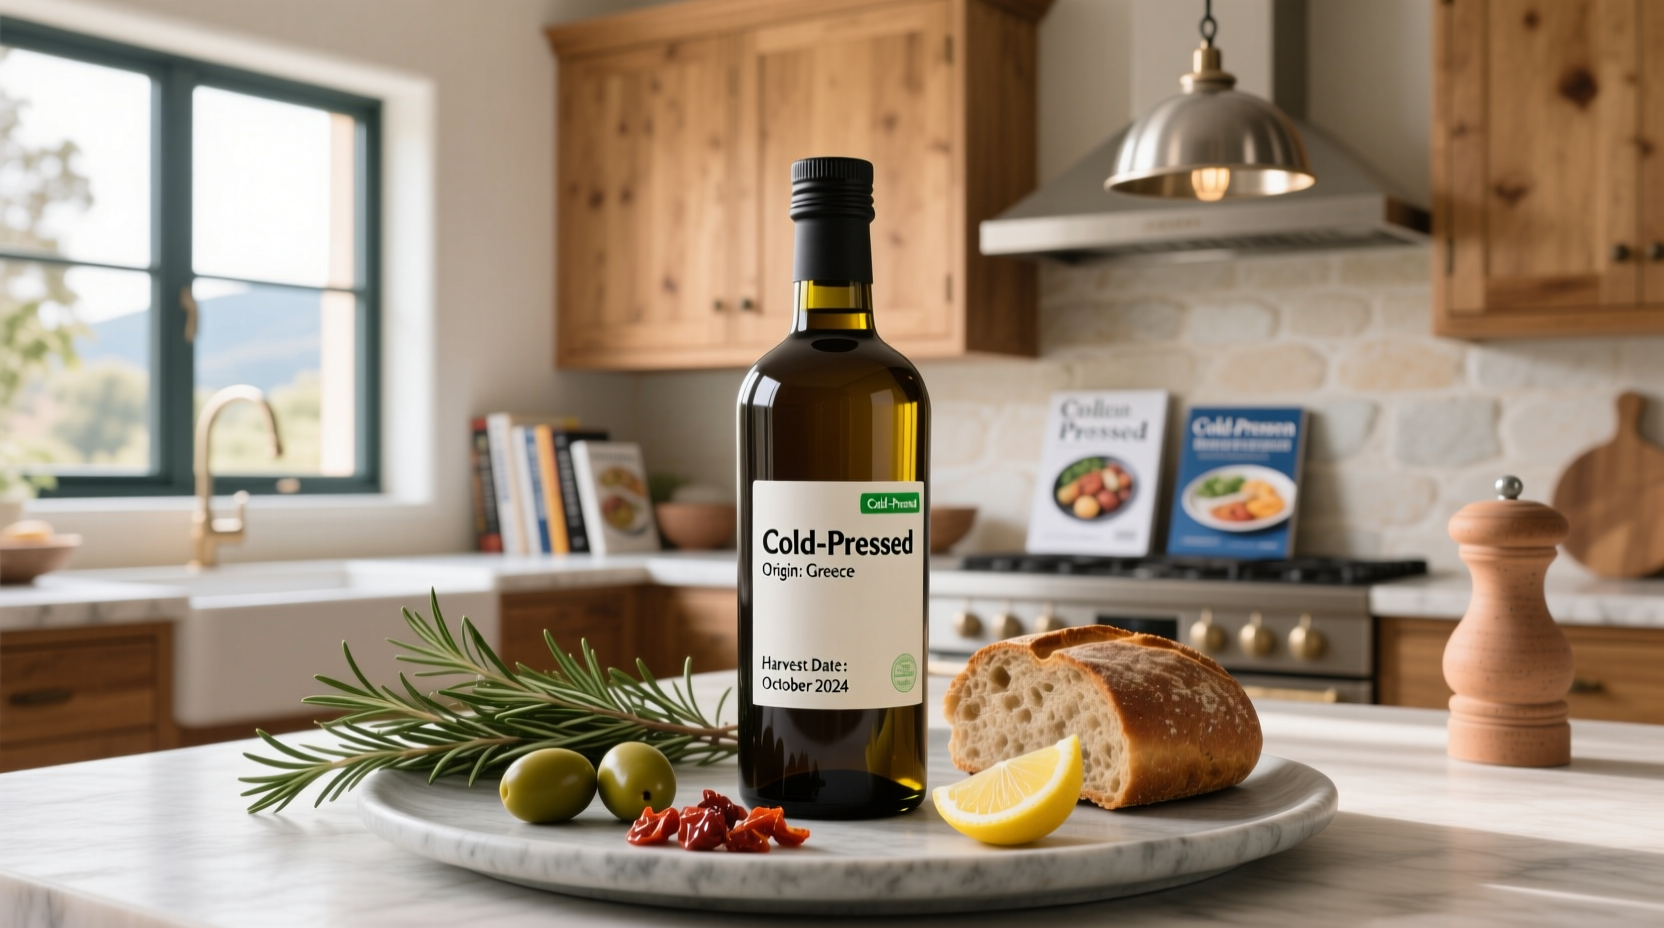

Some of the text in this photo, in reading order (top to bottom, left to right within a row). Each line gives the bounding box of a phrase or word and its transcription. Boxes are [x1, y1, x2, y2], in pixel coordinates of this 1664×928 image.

[762, 528, 914, 556] Cold-Pressed
[762, 562, 856, 582] Origin: Greece
[762, 655, 848, 673] Harvest Date:
[762, 676, 850, 693] October 2024
